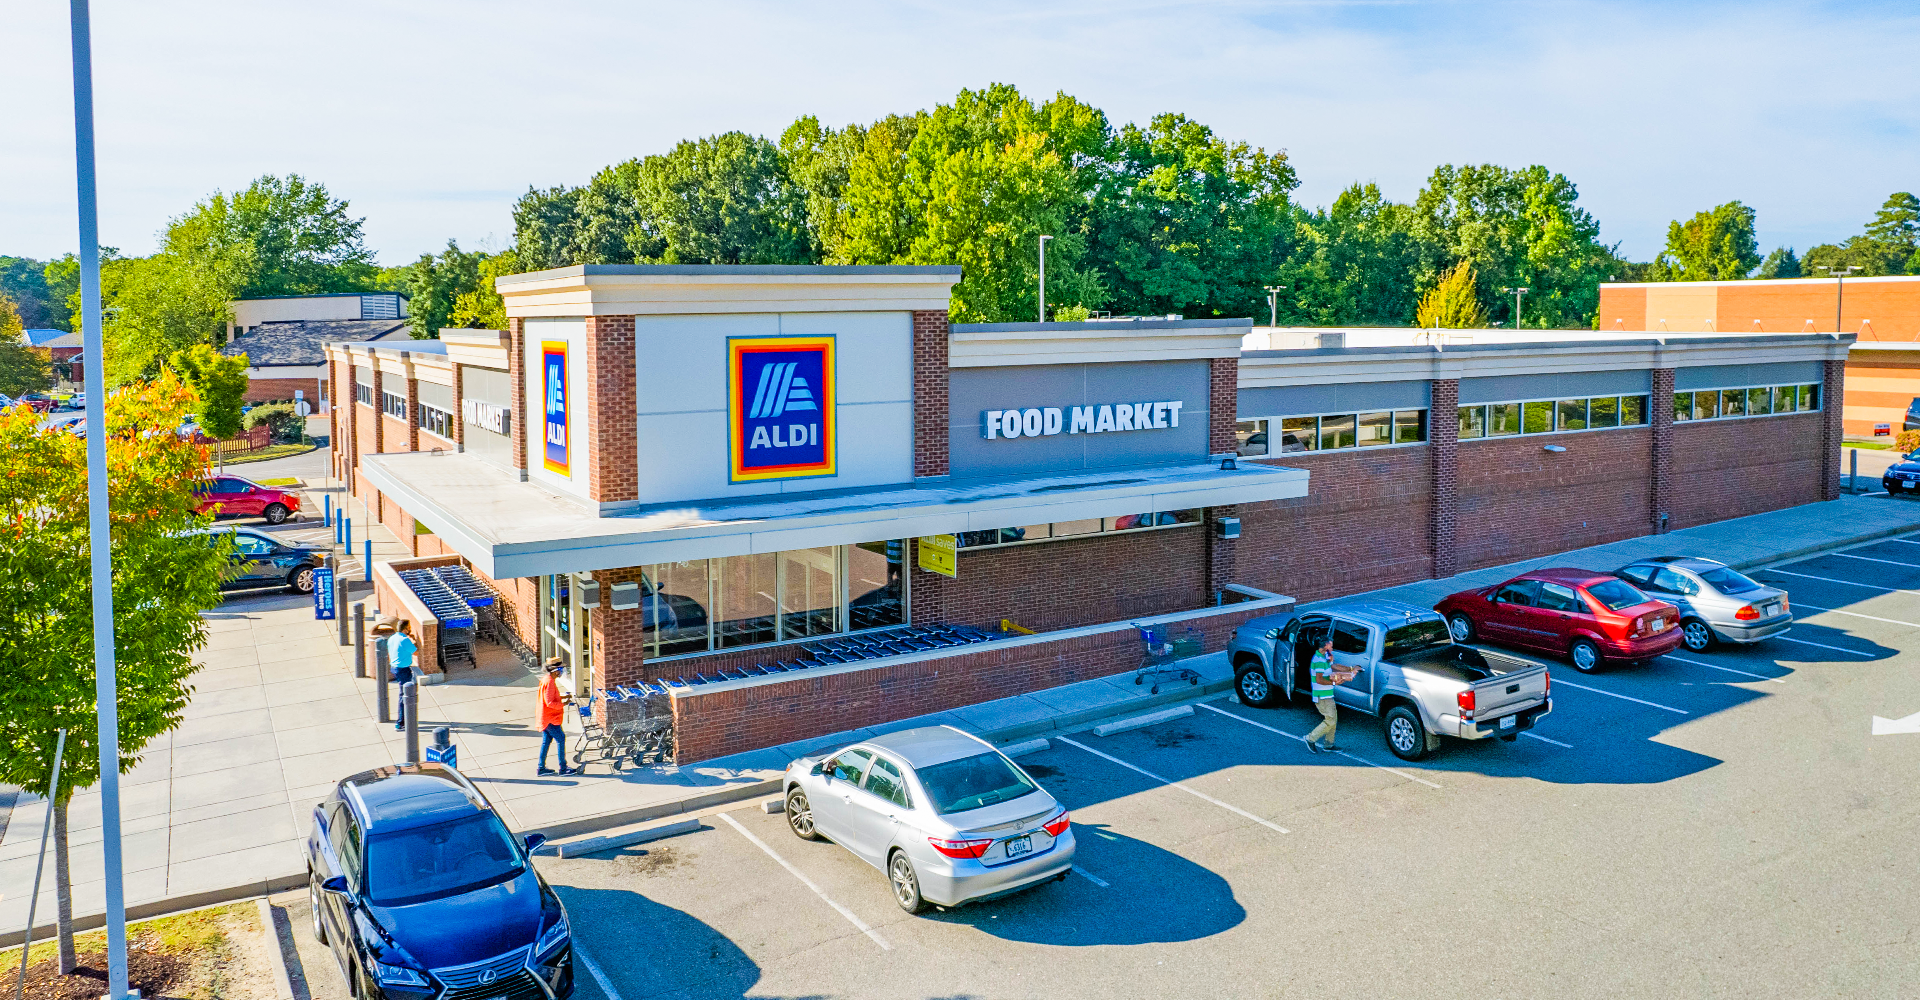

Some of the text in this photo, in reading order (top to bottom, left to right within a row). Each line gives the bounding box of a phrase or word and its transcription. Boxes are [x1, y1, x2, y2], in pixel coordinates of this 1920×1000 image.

[462, 399, 505, 436] FOOD MARKET
[986, 401, 1183, 440] FOOD MARKET
[547, 421, 566, 447] ALDI
[750, 423, 817, 449] ALDI
[317, 575, 325, 593] work
[324, 575, 333, 610] Heroes
